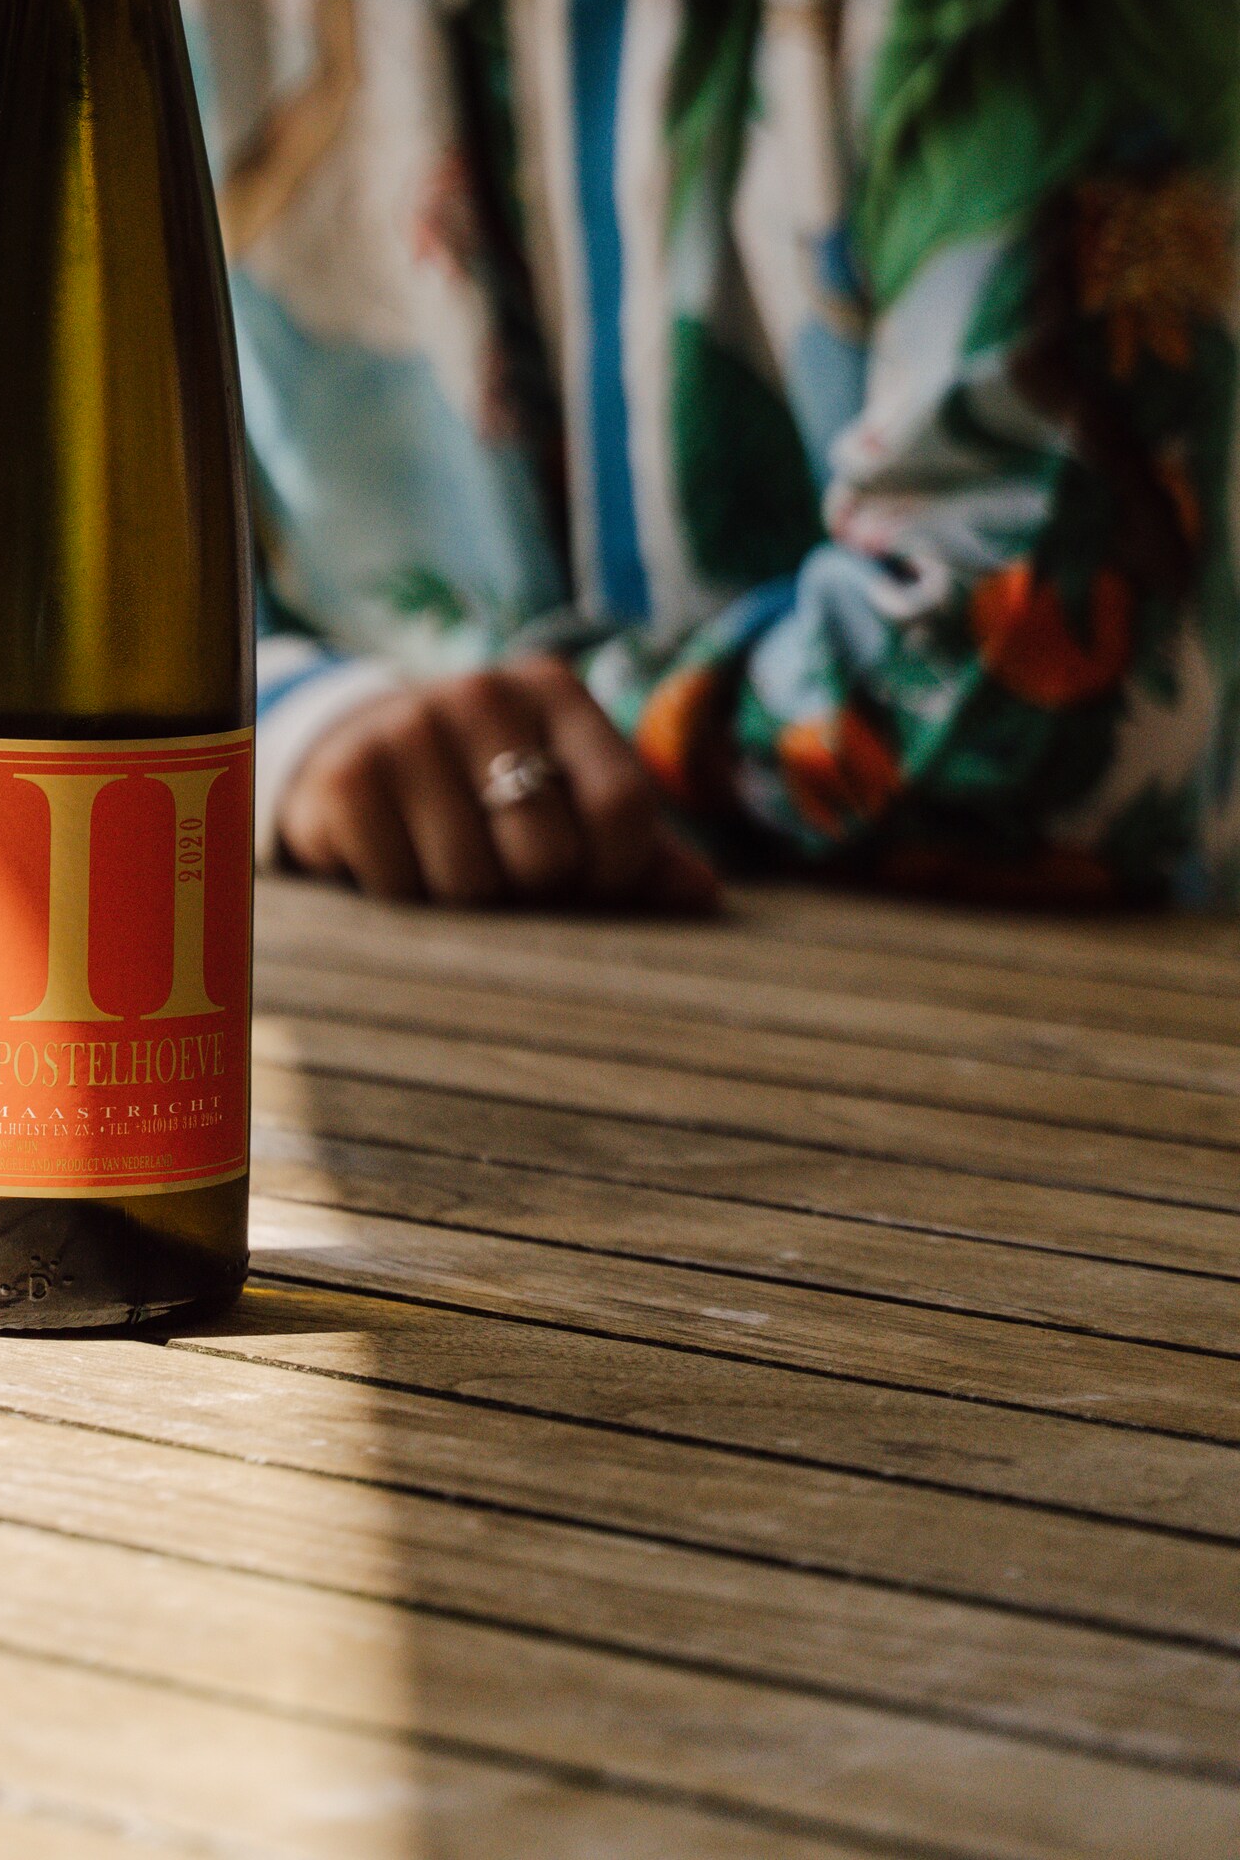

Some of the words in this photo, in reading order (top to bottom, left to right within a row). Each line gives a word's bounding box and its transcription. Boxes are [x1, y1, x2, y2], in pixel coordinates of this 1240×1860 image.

[178, 818, 203, 882] 2020
[109, 1122, 130, 1136] TEL
[56, 1158, 99, 1172] PRODUCT
[101, 1157, 121, 1171] VAN
[122, 1153, 173, 1170] NEDERLAND
